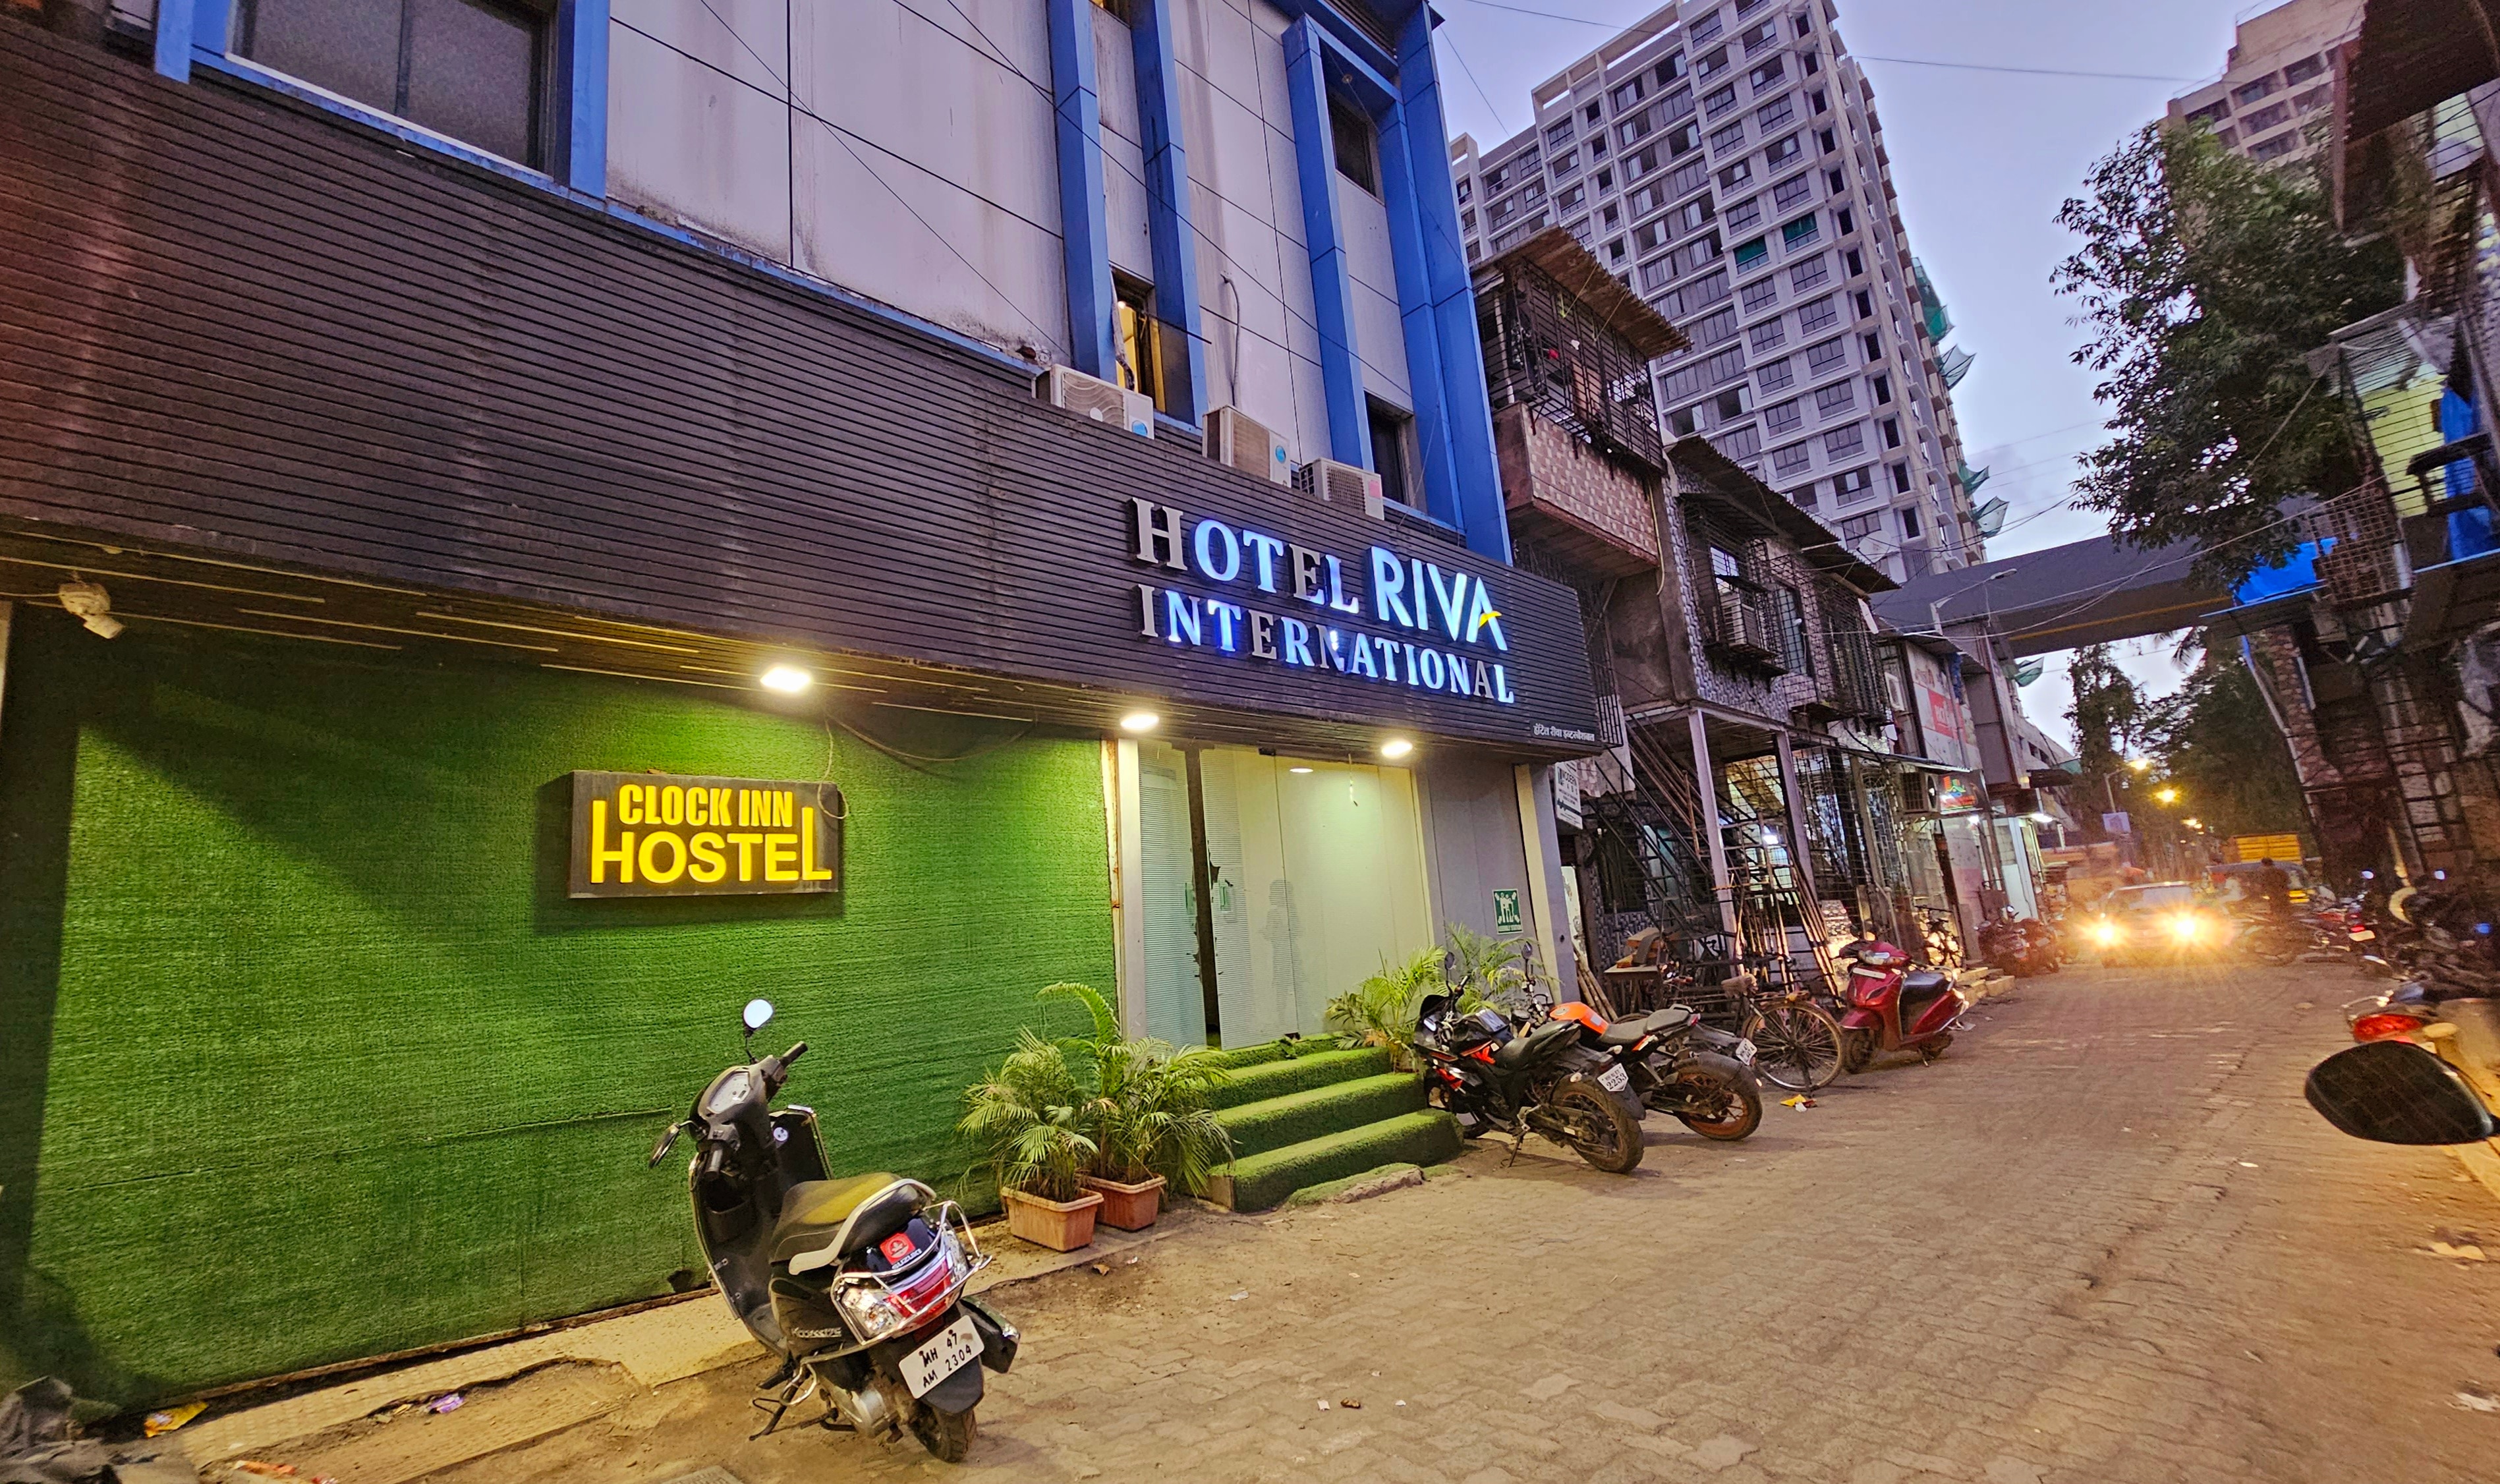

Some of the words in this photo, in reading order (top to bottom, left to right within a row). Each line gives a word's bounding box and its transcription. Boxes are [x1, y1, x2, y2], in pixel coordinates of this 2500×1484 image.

[1131, 496, 1359, 614] HOTEL
[1370, 546, 1508, 652] RIVA
[1137, 583, 1514, 704] INTERNATIONAL
[618, 784, 732, 826] CLOCK
[739, 789, 793, 828] INN
[590, 799, 832, 884] HOSTEL
[1606, 1073, 1627, 1090] 2253
[922, 1348, 938, 1367] MH
[946, 1332, 957, 1349] 47
[923, 1369, 939, 1388] AM
[945, 1344, 972, 1372] 2304
